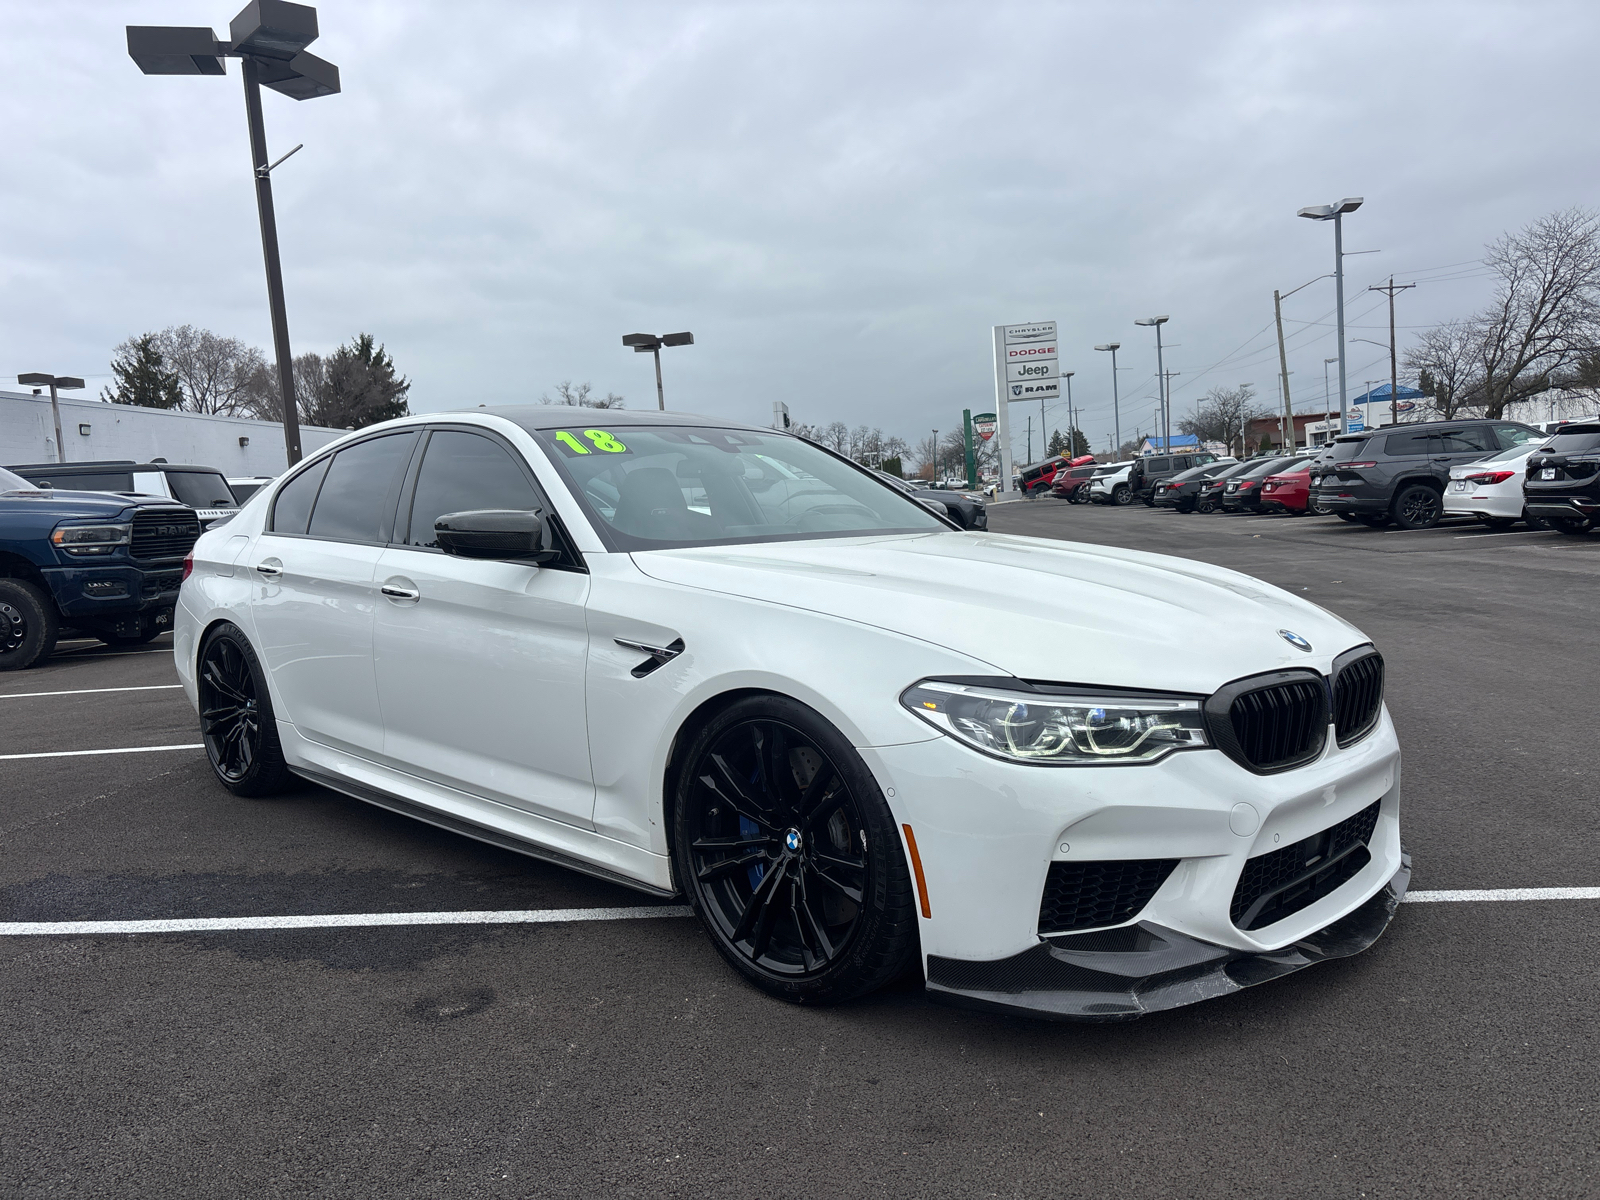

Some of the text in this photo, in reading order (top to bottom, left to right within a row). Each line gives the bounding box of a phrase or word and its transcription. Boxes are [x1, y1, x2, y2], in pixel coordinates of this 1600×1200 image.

[1009, 326, 1053, 334] CHRYSLER
[1009, 347, 1056, 357] DODGE
[1018, 365, 1049, 376] Jeep
[1025, 385, 1057, 393] RAM
[555, 429, 627, 455] 18
[157, 524, 189, 535] RAM
